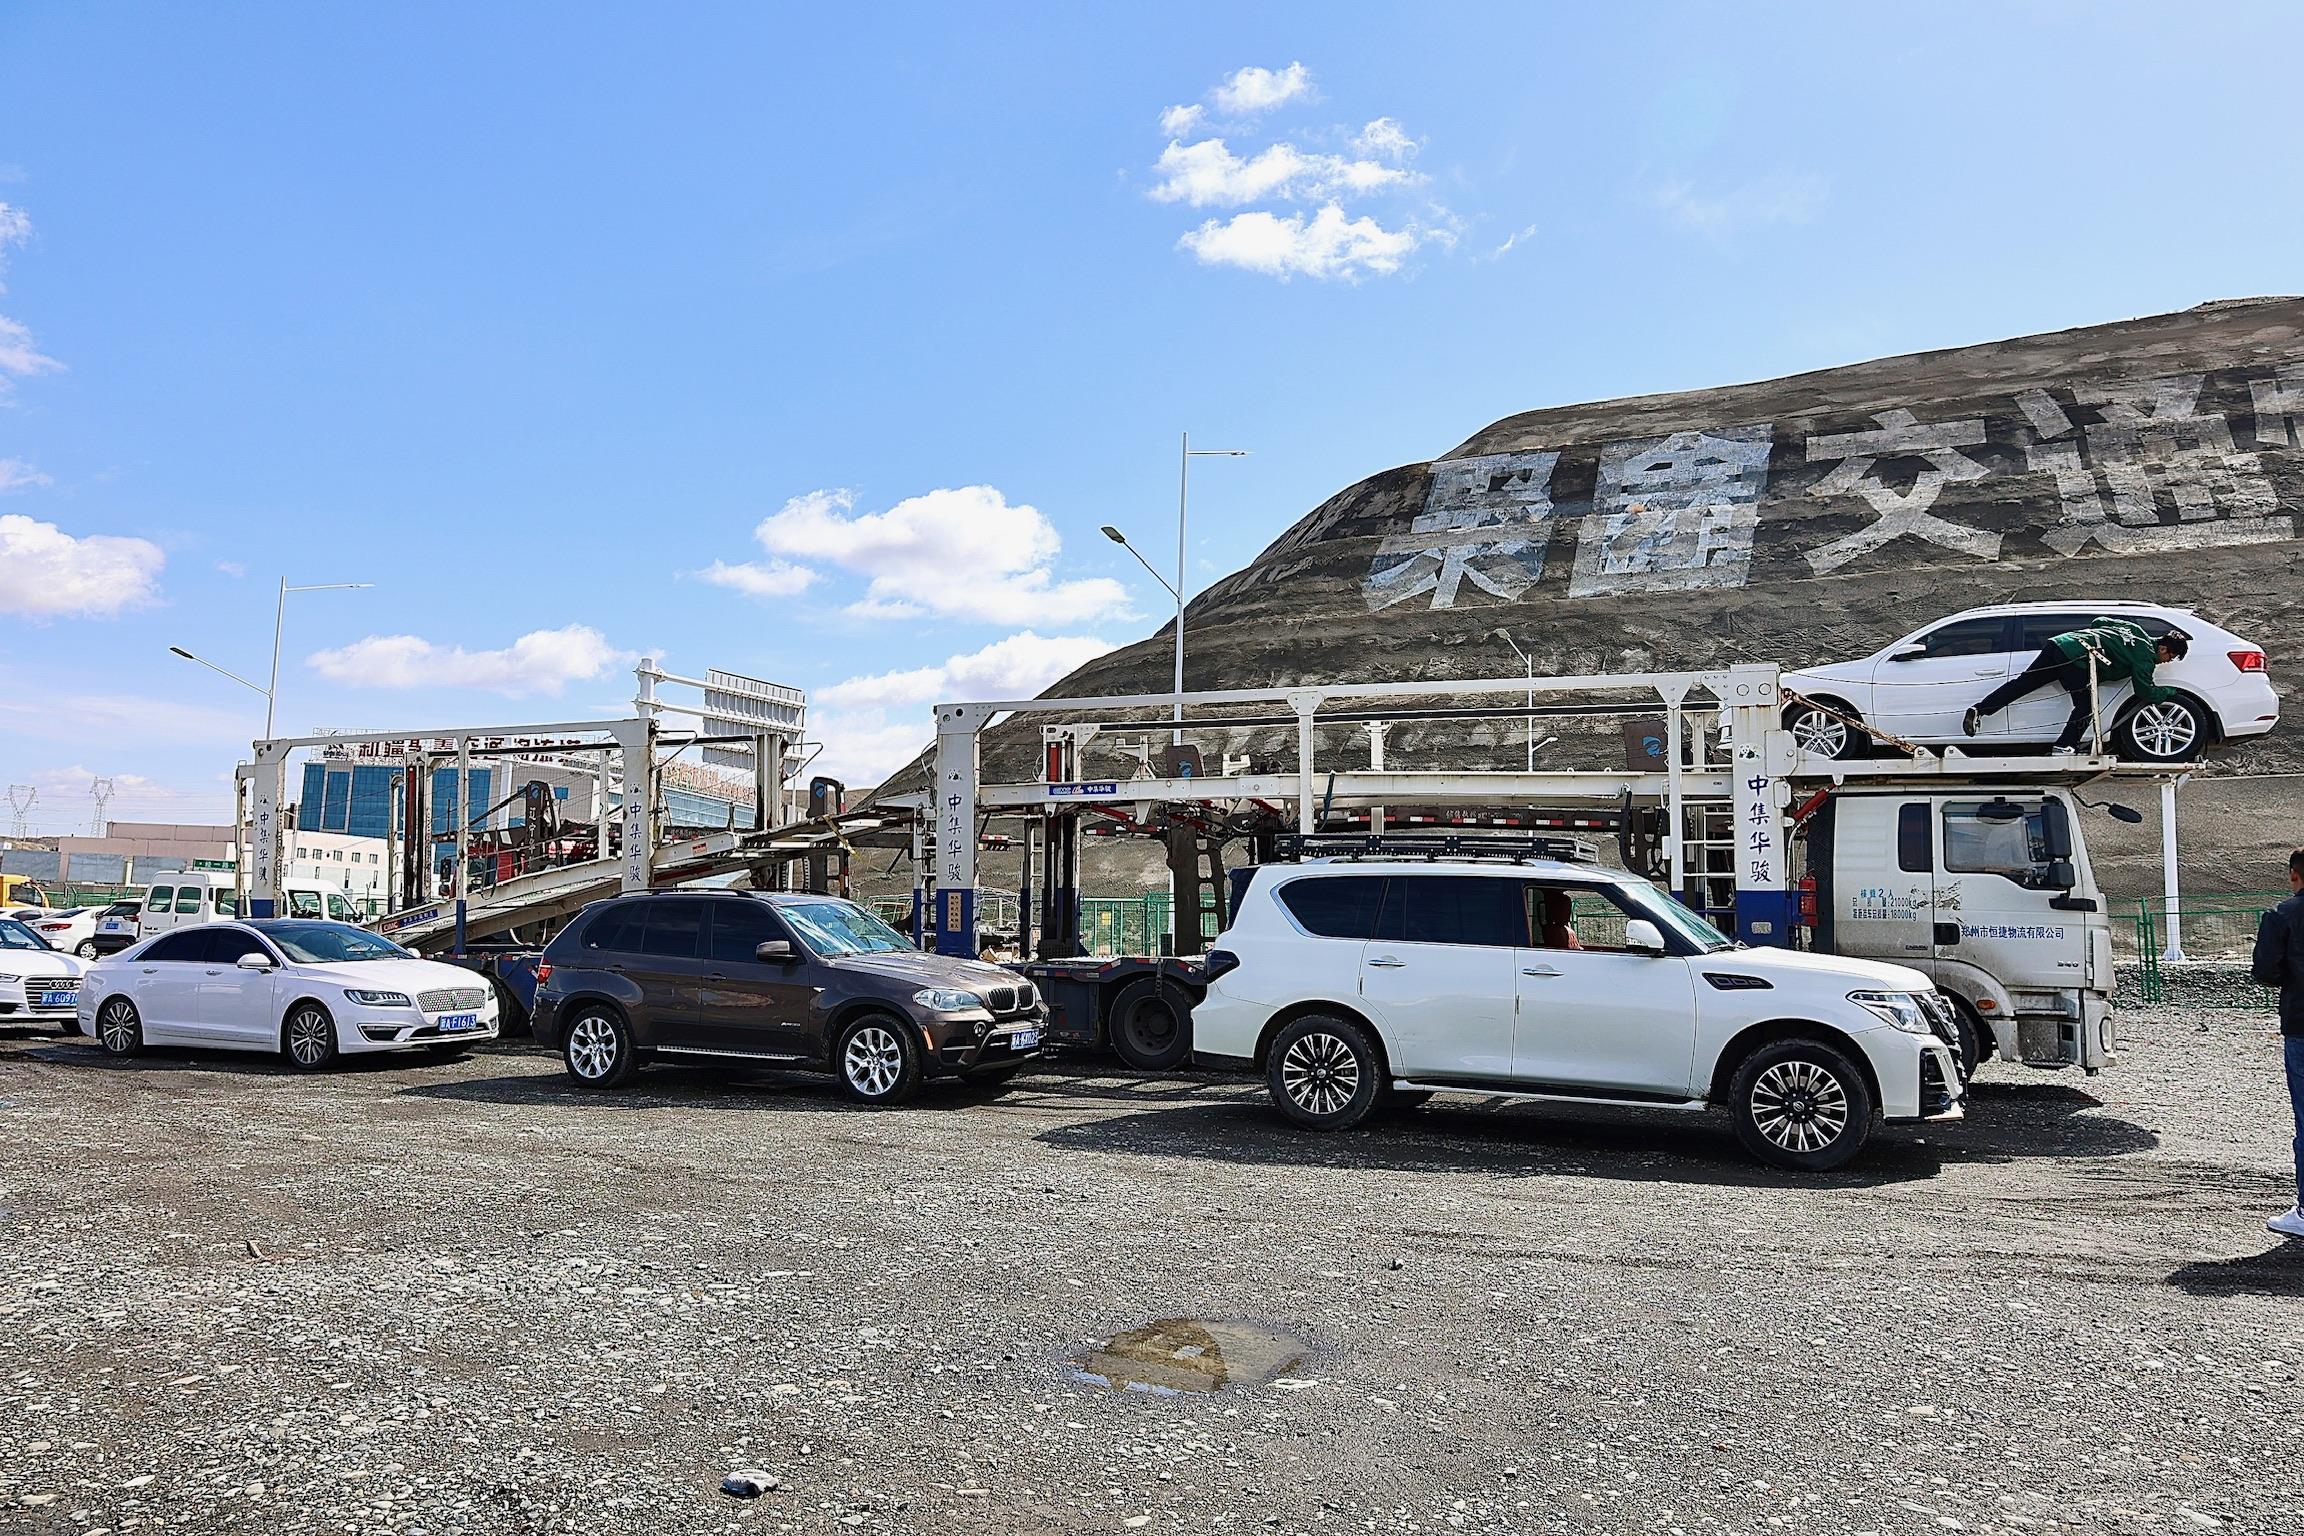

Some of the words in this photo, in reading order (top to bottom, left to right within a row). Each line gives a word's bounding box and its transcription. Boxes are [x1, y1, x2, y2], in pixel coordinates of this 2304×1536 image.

[259, 811, 270, 884] 中集华骏
[629, 801, 642, 882] 中集华骏
[948, 793, 963, 881] 中集华骏
[1748, 775, 1772, 884] 中集华骏
[1961, 926, 2064, 939] 郑州市恒捷物流有限公司
